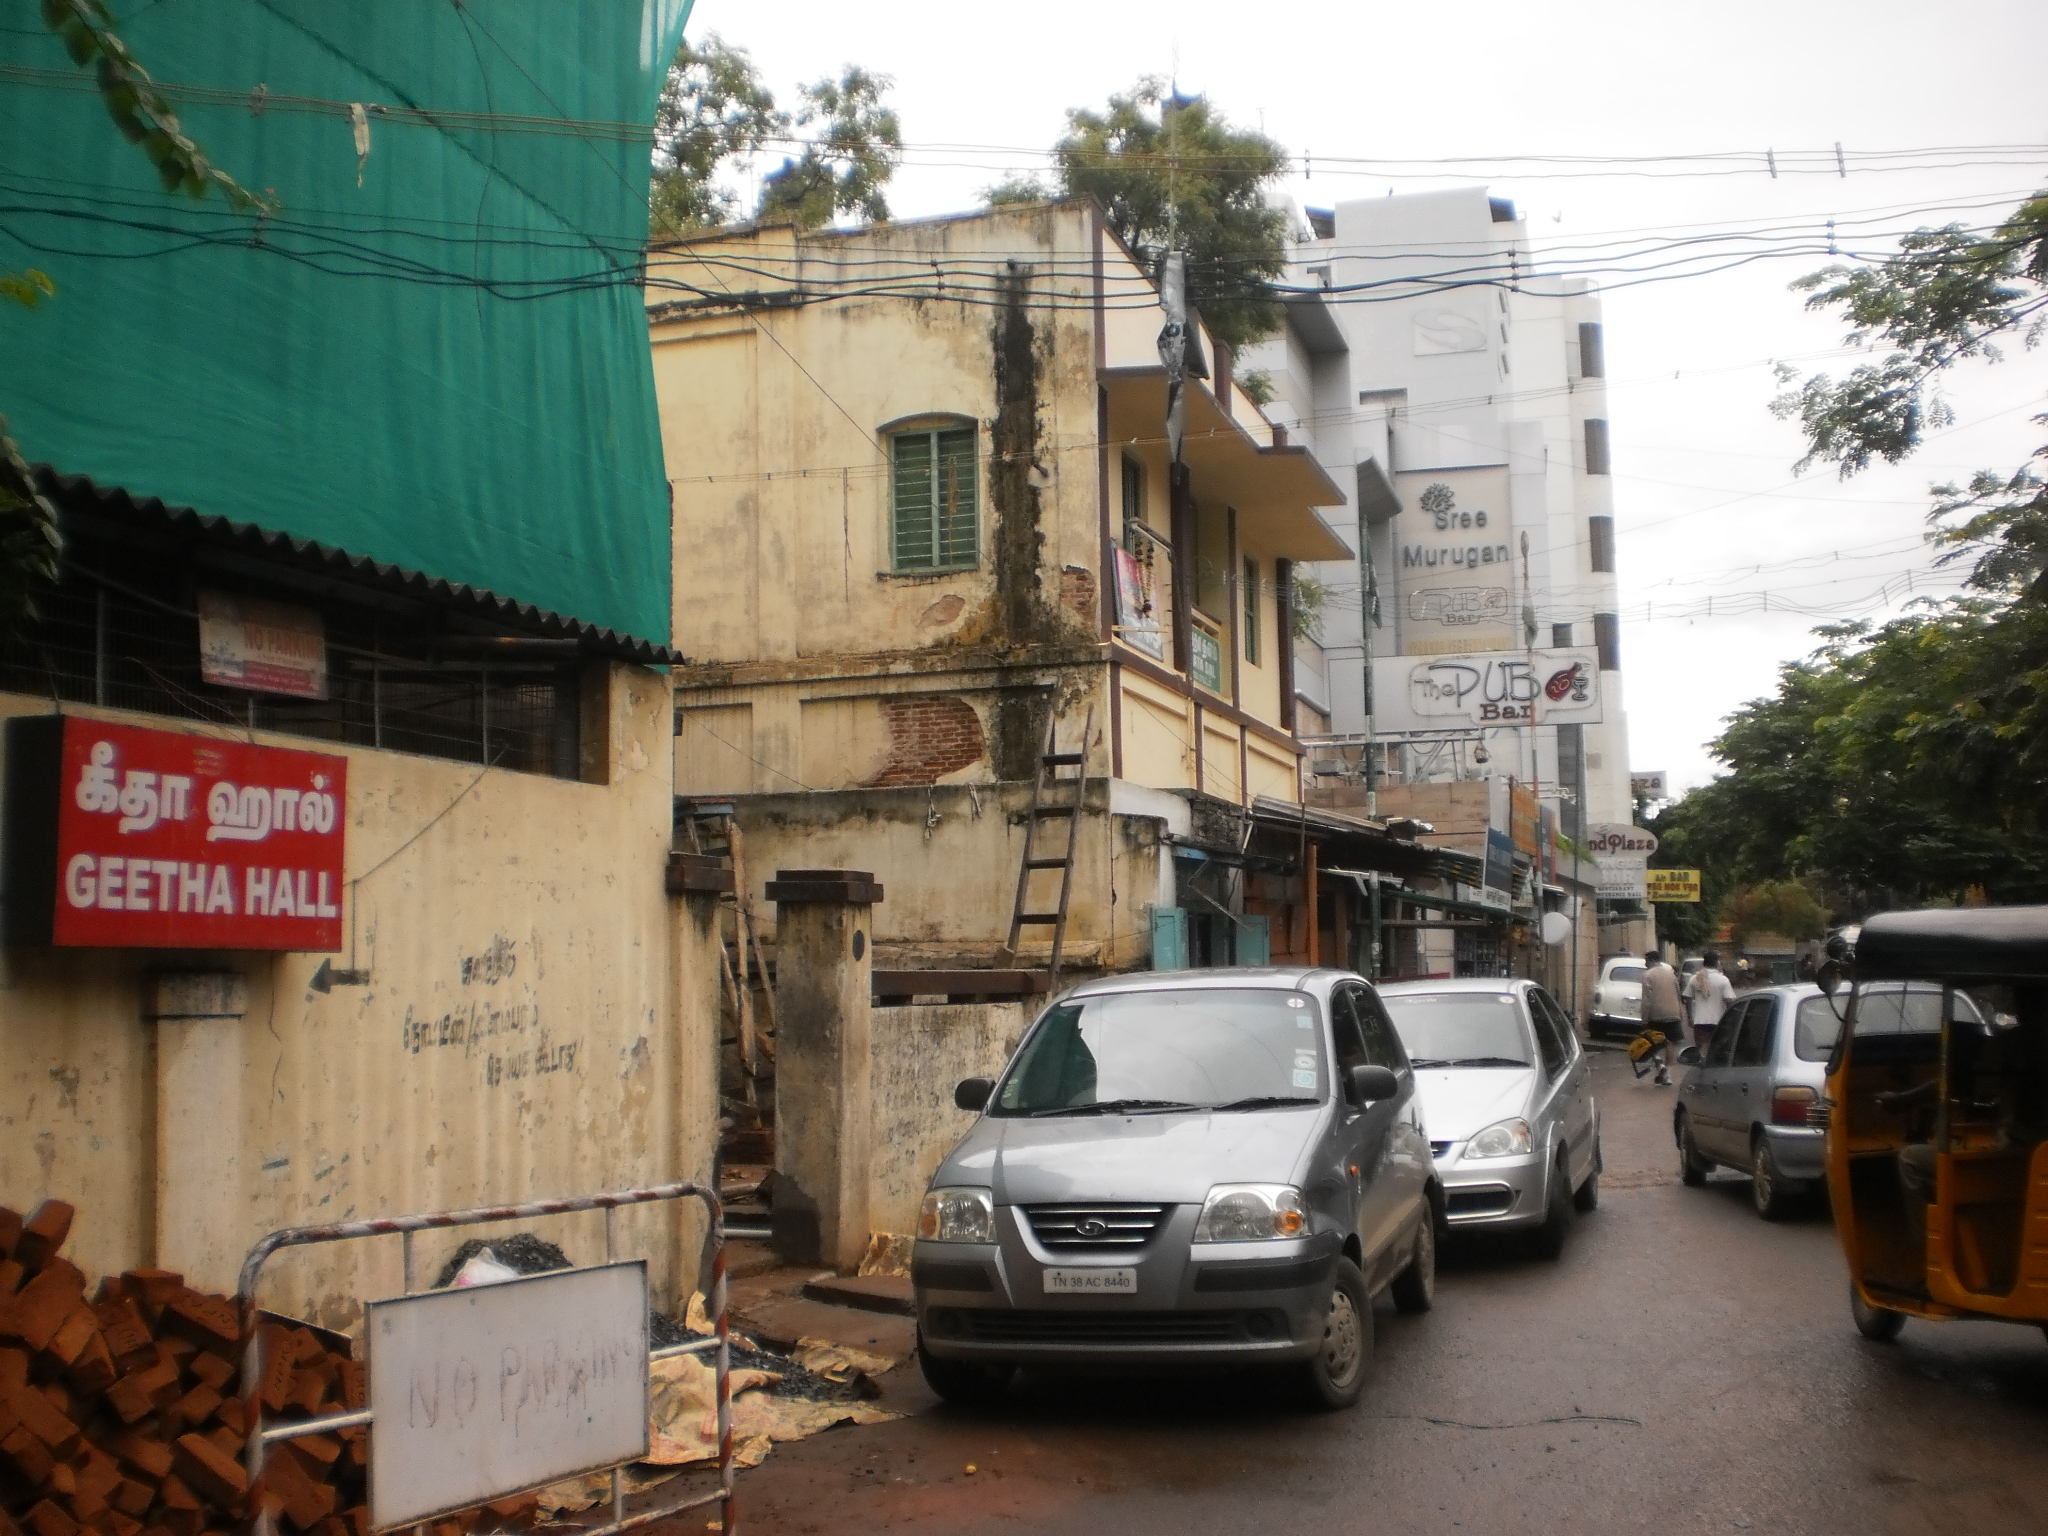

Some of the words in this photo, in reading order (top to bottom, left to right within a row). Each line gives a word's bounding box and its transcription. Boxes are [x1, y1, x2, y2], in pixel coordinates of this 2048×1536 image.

[1435, 509, 1488, 530] Sree
[1403, 544, 1509, 569] Murugan
[1429, 661, 1541, 708] PUB
[75, 741, 192, 834] கீதா
[206, 773, 336, 842] ஹால்
[1608, 834, 1655, 854] Plaza
[65, 853, 234, 916] GEETHA
[244, 866, 338, 919] HALL
[1052, 1277, 1067, 1288] TN
[1070, 1277, 1083, 1288] 38
[1085, 1277, 1101, 1288] AC
[1104, 1277, 1130, 1288] 8440
